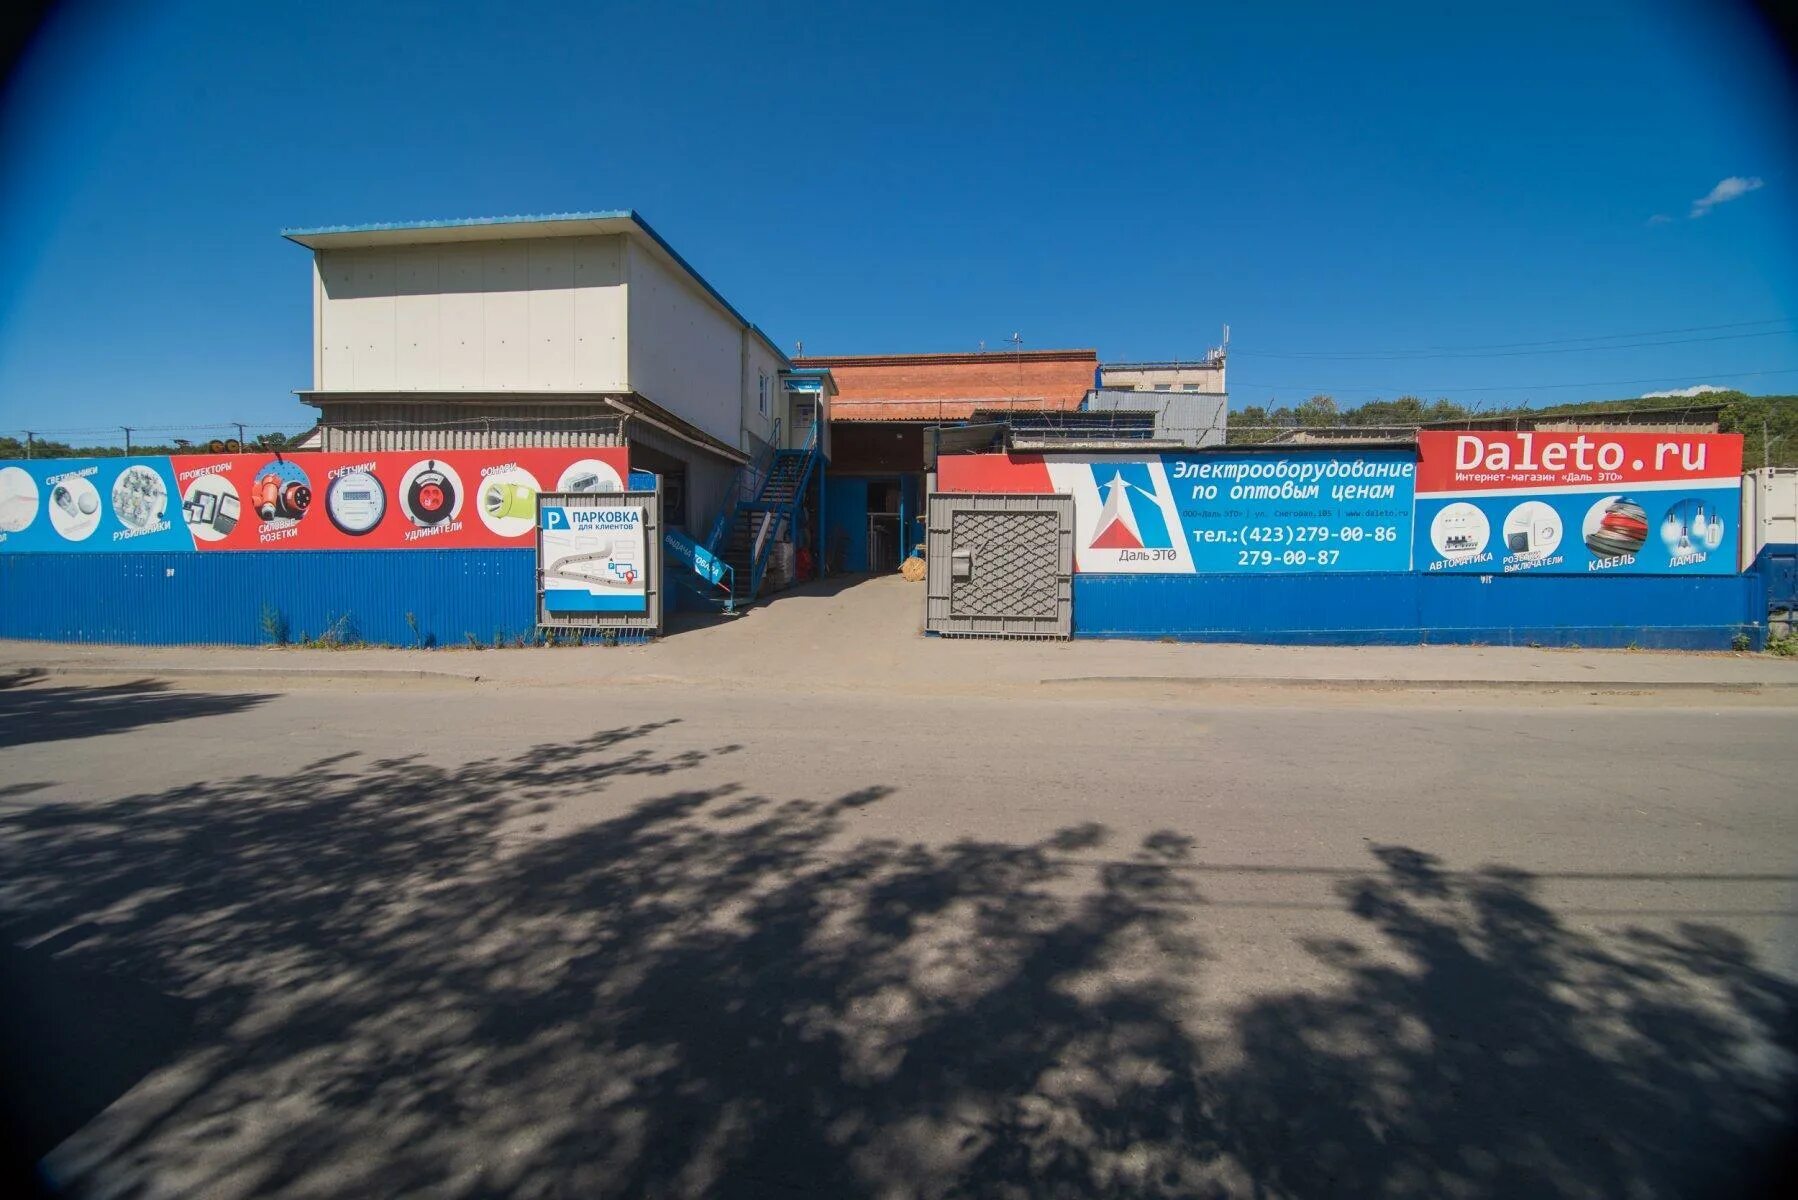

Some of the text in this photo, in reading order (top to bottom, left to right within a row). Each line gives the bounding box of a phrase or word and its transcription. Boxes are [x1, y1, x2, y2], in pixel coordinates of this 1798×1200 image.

[1455, 433, 1707, 471] Daleto.ru
[179, 462, 232, 481] ПРОЖЕКТОРЫ
[327, 461, 377, 480] СЧЁТЧИКИ
[1173, 459, 1414, 483] Электрооборудование
[1455, 473, 1555, 483] Интернет-магазин
[1192, 481, 1395, 502] по оптовым ценам
[572, 511, 639, 523] ПАРКОВКА
[112, 520, 171, 541] РУБИЛЬНИКИ
[260, 528, 298, 543] РОЗЕТКИ
[404, 521, 463, 542] УДЛИНИТЕЛИ
[664, 535, 692, 558] ВЫДАЧА
[1119, 550, 1150, 562] Даль
[1237, 550, 1340, 566] 279-00-87
[1429, 552, 1493, 572] АВТОМАТИКА
[1504, 555, 1563, 573] ВЫКЛЮЧАТЕЛИ
[1588, 554, 1635, 571] КАБЕЛЬ
[1668, 551, 1707, 568] ЛАМПЫ
